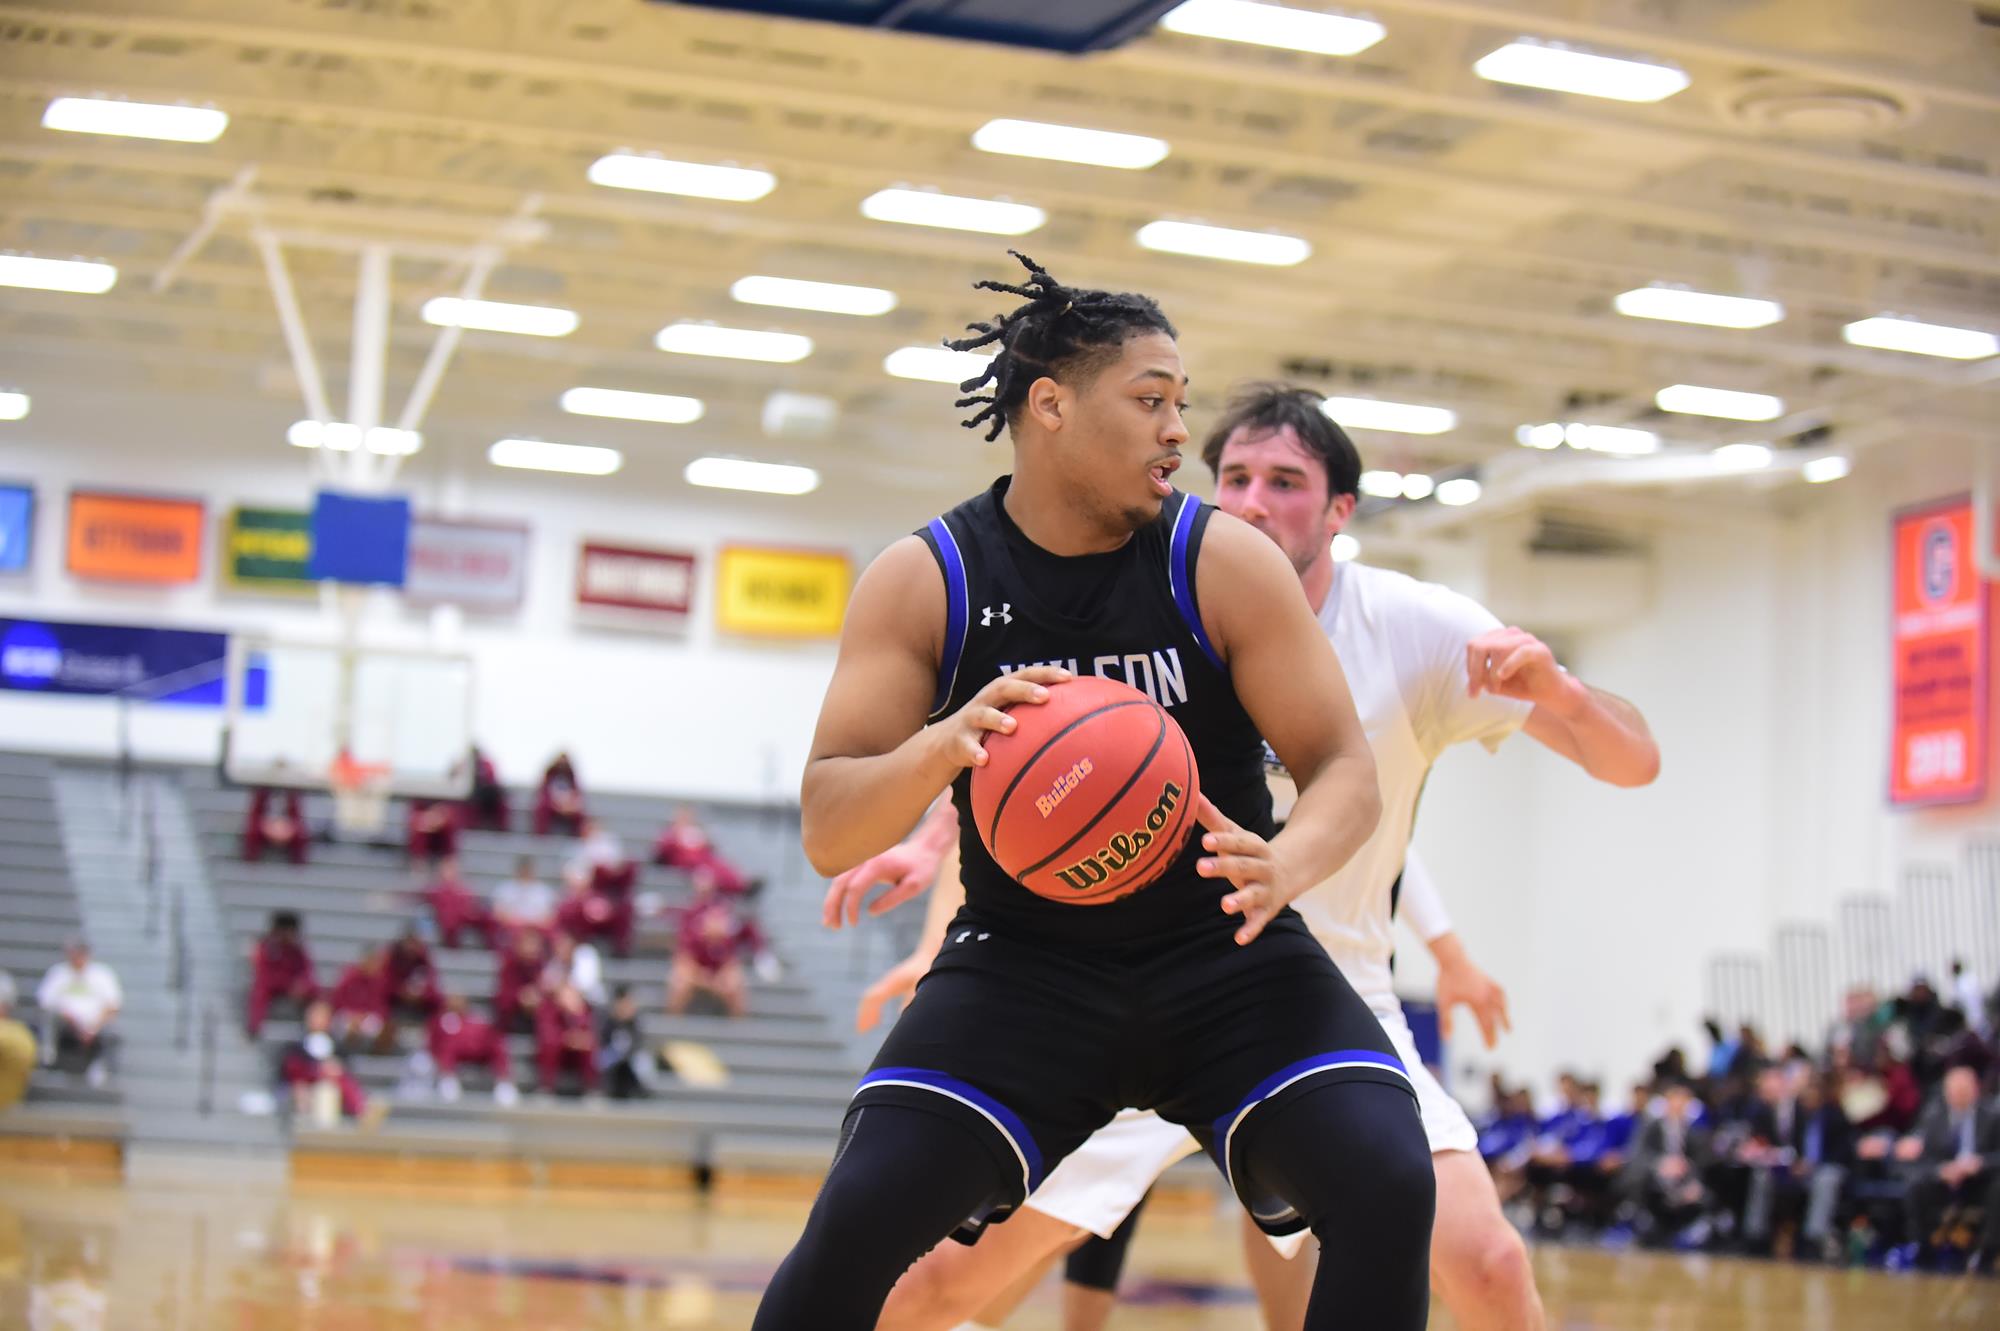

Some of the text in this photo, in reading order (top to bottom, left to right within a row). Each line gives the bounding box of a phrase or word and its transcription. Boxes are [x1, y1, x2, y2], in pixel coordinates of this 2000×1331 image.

[999, 647, 1188, 708] SON
[1035, 757, 1094, 819] Bullets
[1053, 780, 1183, 891] Wilson
